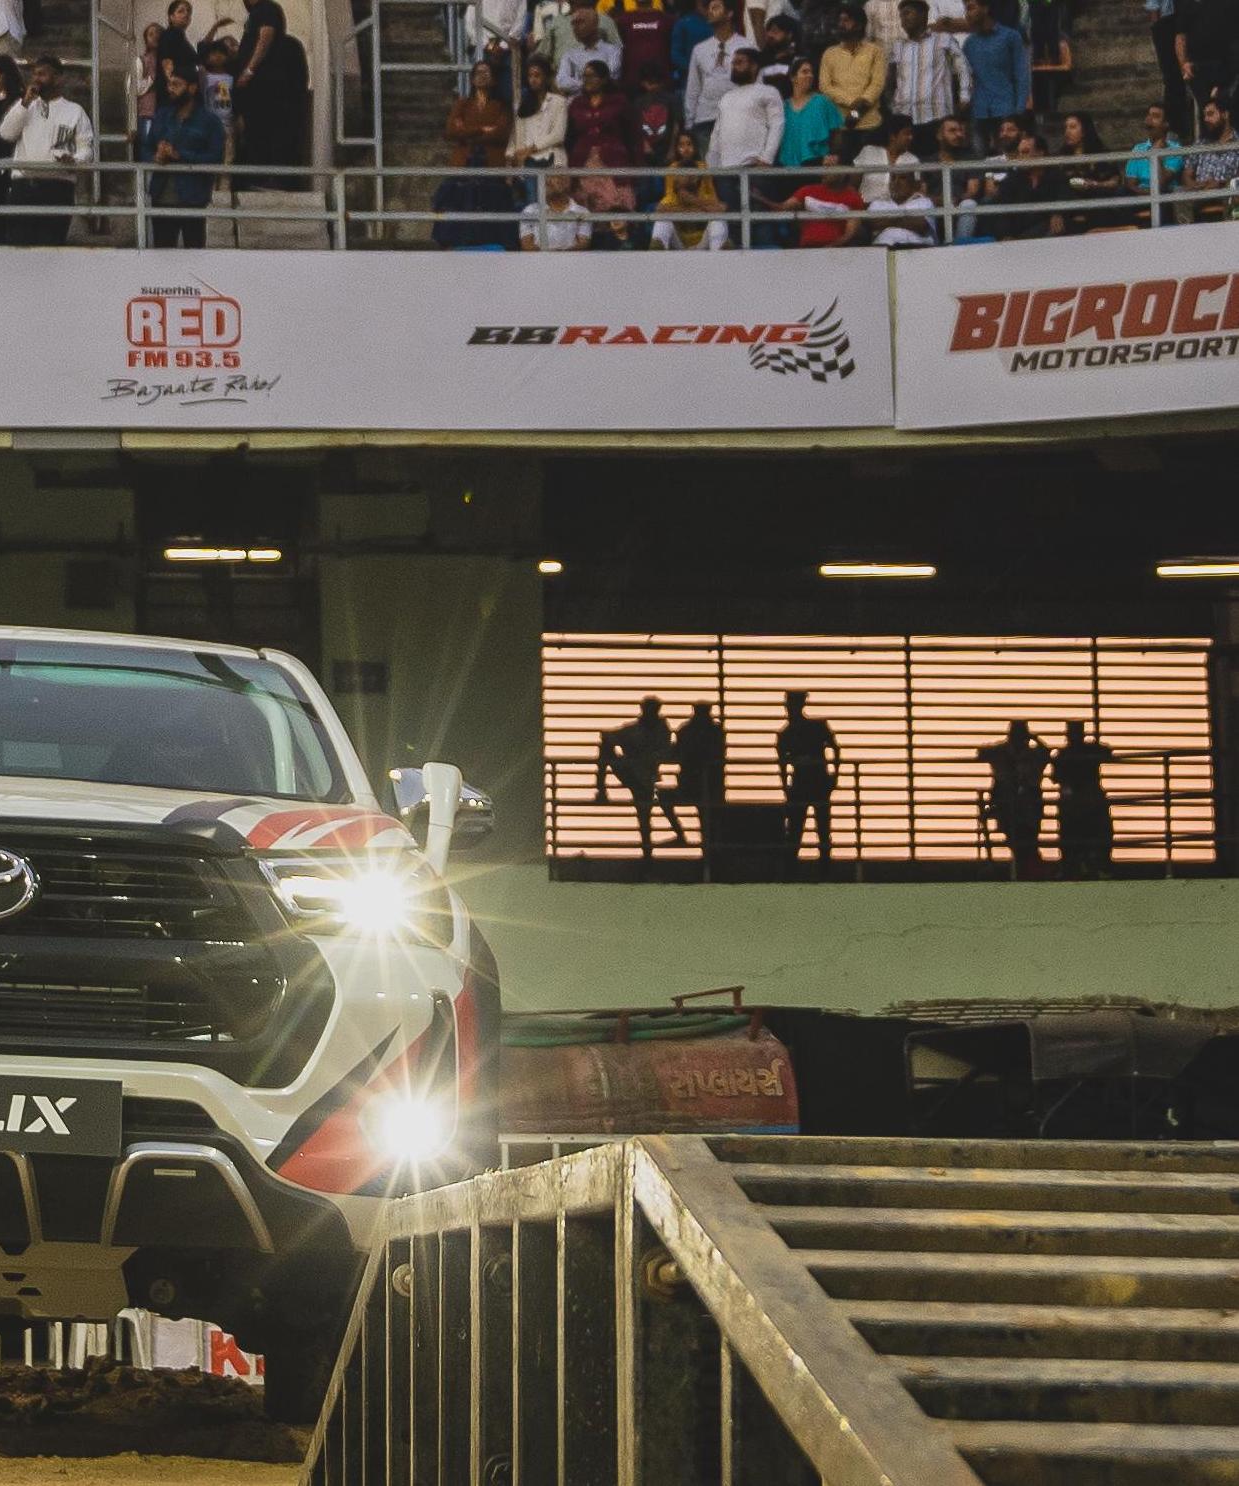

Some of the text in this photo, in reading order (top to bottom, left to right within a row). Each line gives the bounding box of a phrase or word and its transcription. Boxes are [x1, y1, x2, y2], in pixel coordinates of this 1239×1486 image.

[141, 286, 201, 296] superhits
[129, 299, 240, 346] RED
[128, 350, 241, 368] FM 93.5
